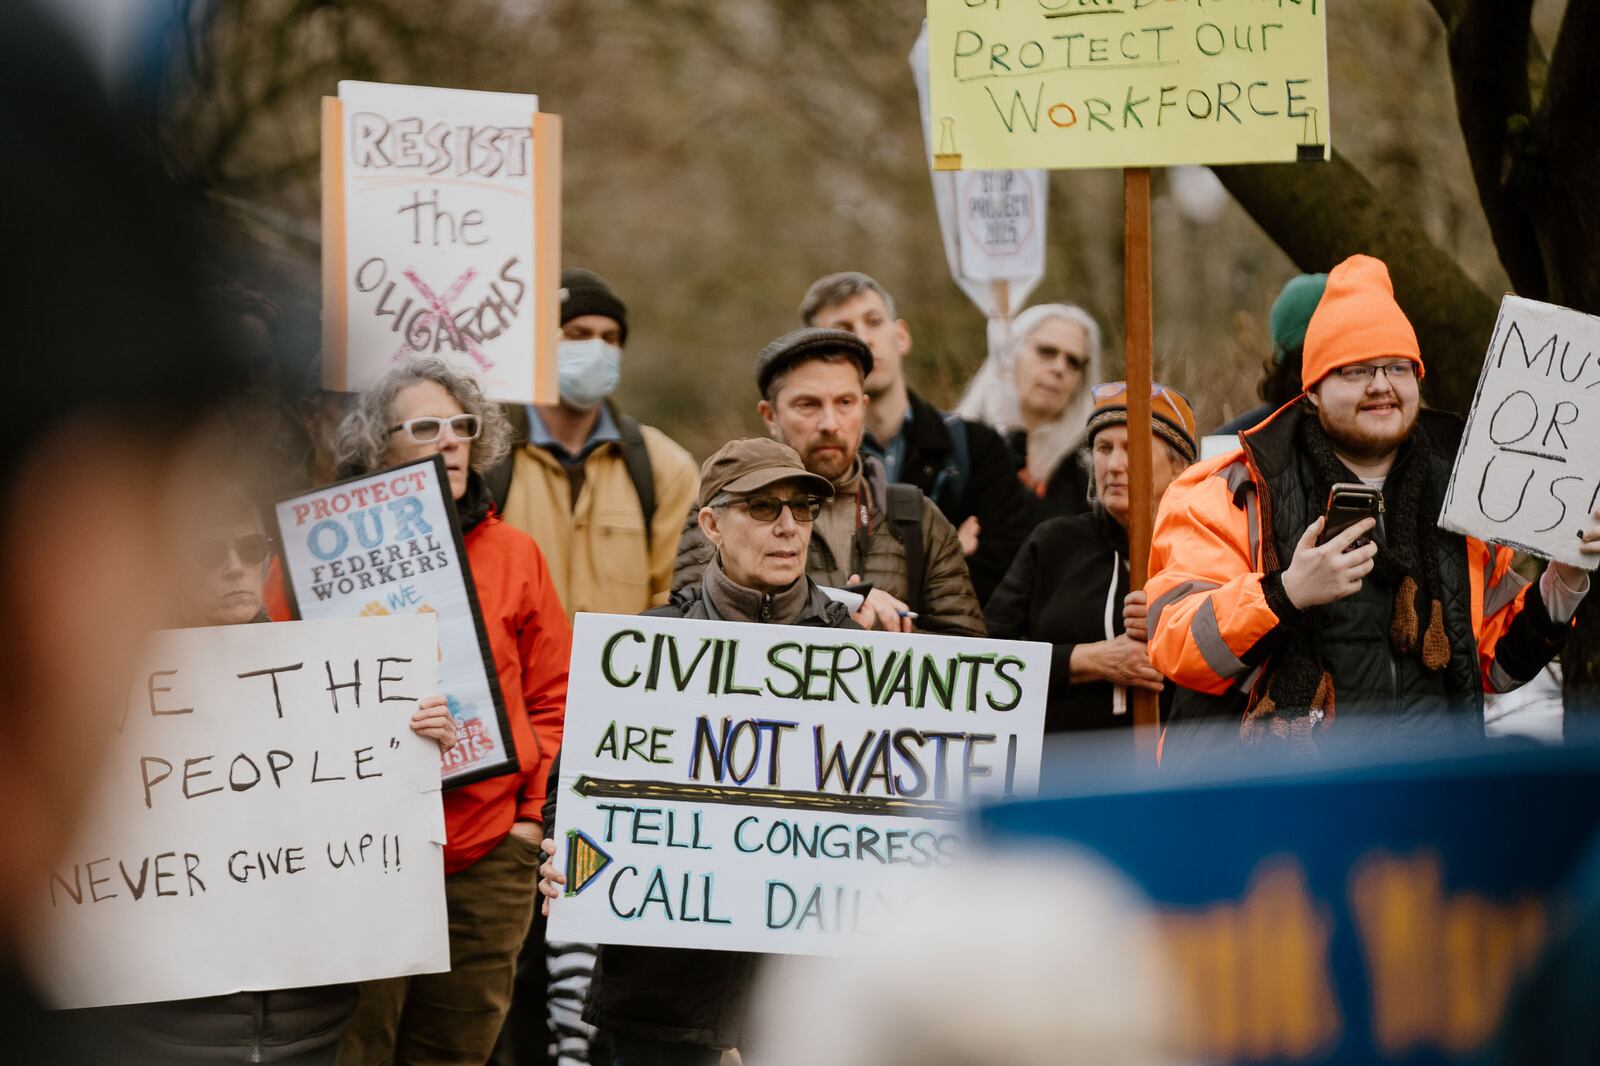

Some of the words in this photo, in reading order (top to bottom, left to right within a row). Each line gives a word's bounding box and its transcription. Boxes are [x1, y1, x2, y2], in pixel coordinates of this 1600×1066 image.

[953, 26, 1173, 77] PROTECT
[985, 79, 1311, 133] WORKFORCE
[350, 111, 533, 177] RESIST
[397, 189, 489, 246] the
[355, 255, 525, 353] OLIGARCHS
[1489, 390, 1579, 449] OR
[291, 470, 427, 526] PROTECT
[306, 495, 433, 560] OUR
[311, 534, 441, 584] FEDERAL
[311, 550, 448, 601] WORKERS
[386, 584, 424, 610] WE
[236, 657, 418, 719] THE
[600, 629, 764, 697] CIVIL
[765, 641, 1027, 713] SERVANTS
[595, 719, 676, 764] ARE
[688, 714, 799, 788] NOT
[596, 804, 712, 850] TELL
[733, 815, 961, 868] CONGRESS
[48, 851, 206, 907] NEVER
[227, 846, 306, 883] GIVE
[326, 833, 402, 874] UP!!
[606, 866, 733, 926] CALL
[764, 879, 913, 937] DAIL
